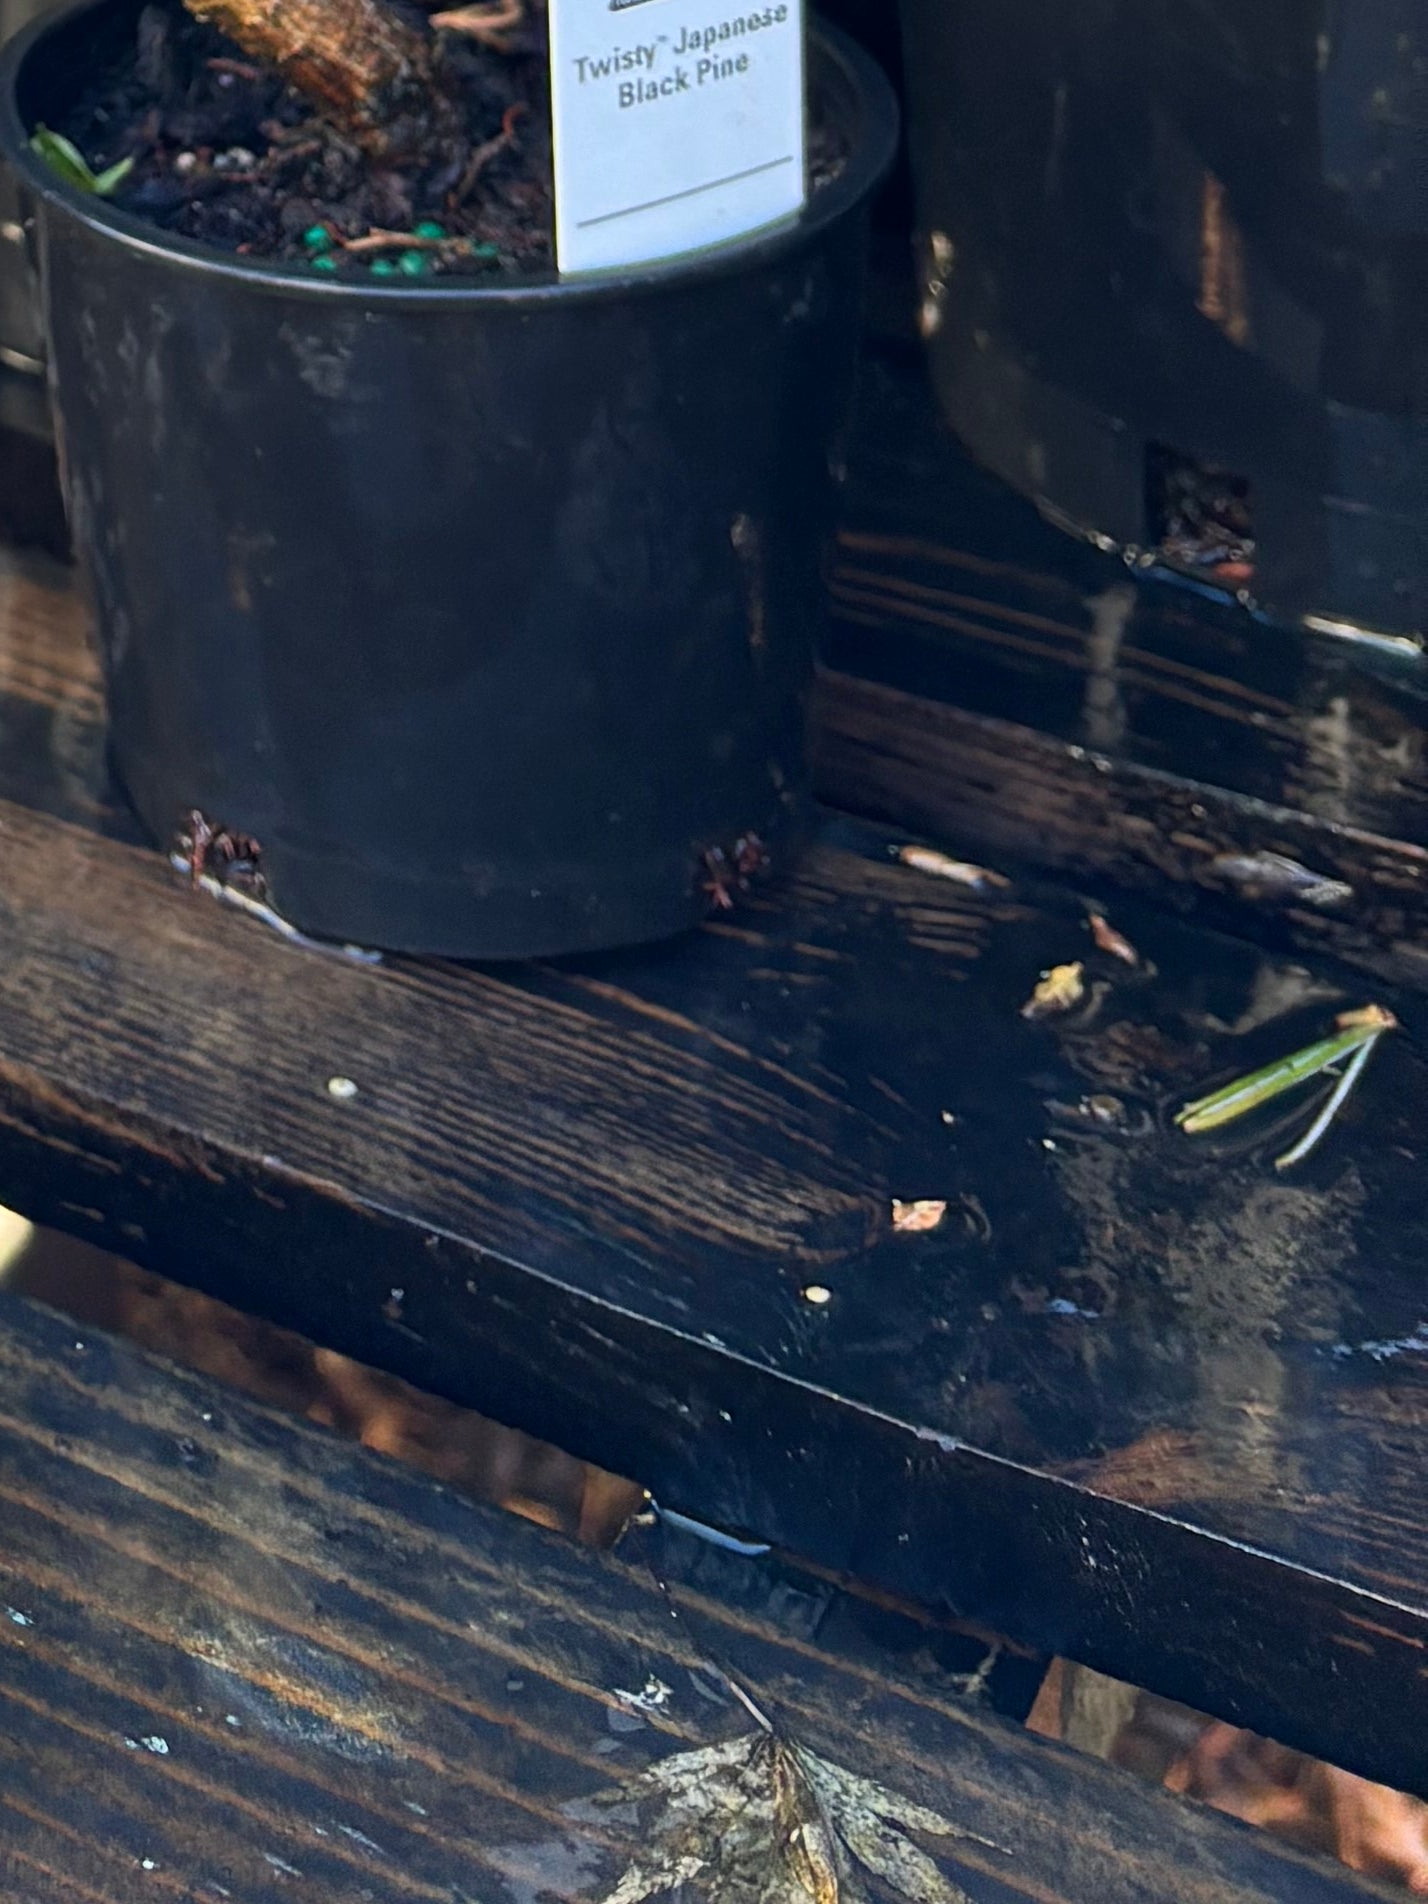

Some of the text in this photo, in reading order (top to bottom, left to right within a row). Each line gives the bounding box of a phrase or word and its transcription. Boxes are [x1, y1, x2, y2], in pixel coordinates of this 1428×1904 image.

[673, 3, 788, 54] Japanese
[618, 53, 749, 109] Black Pine
